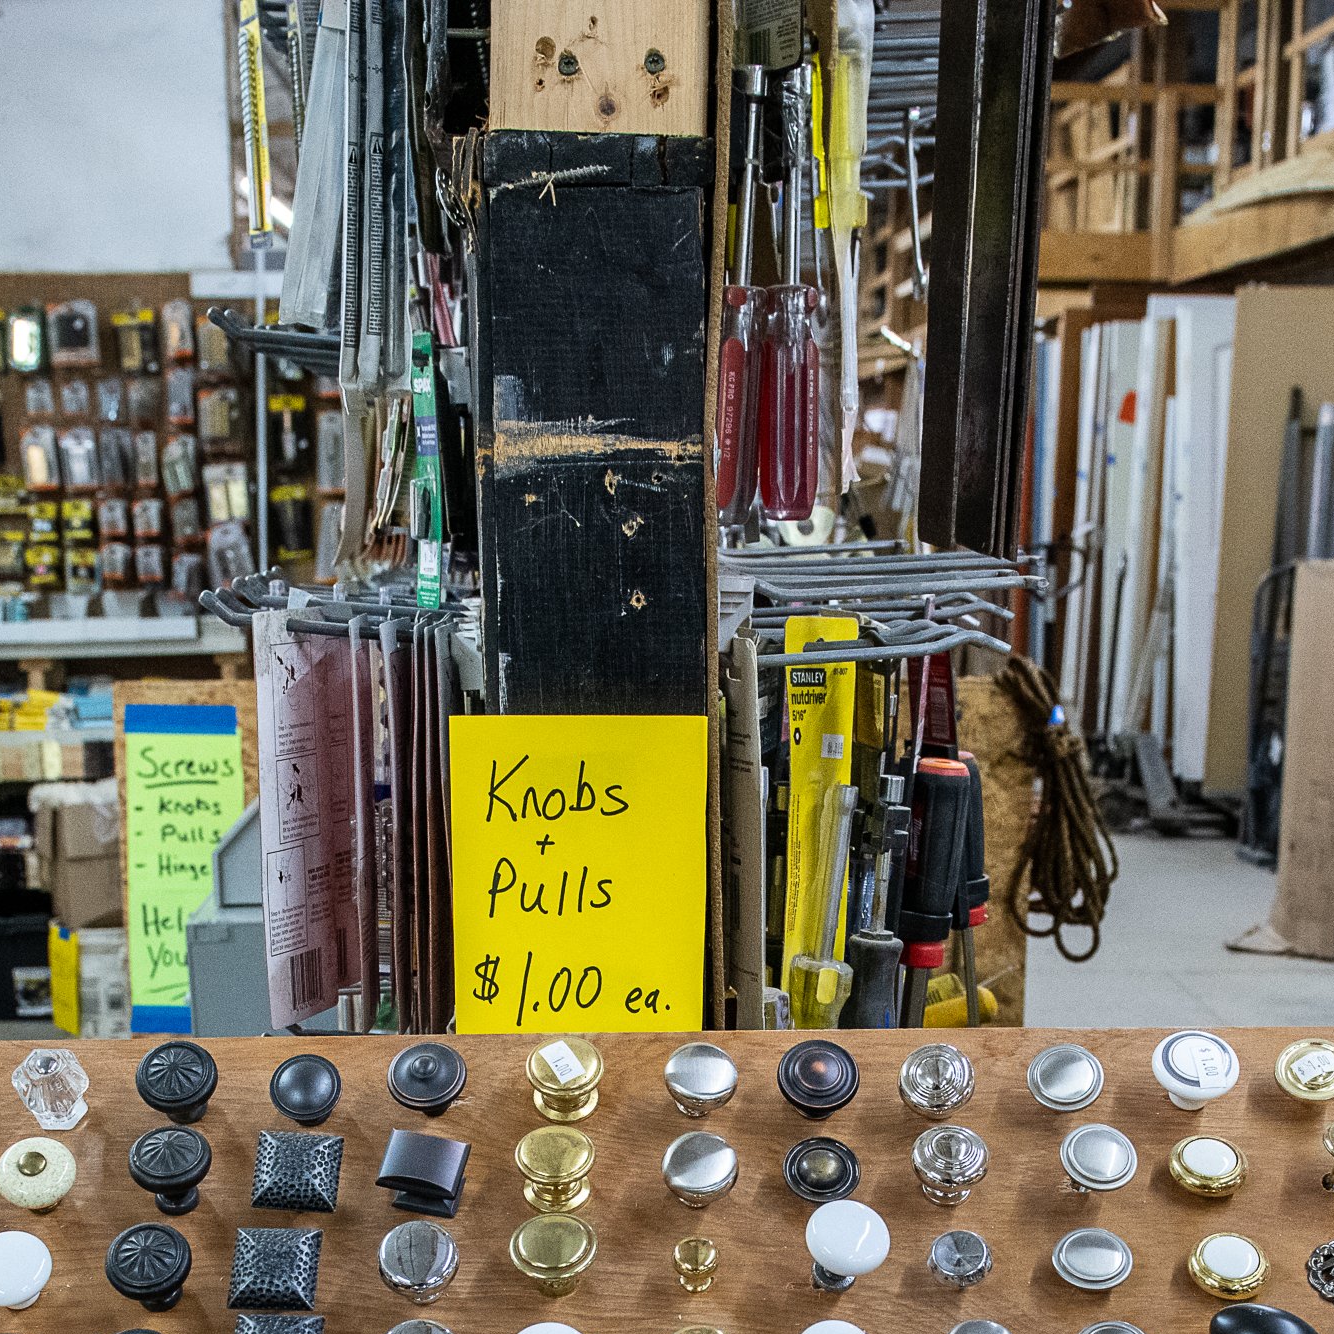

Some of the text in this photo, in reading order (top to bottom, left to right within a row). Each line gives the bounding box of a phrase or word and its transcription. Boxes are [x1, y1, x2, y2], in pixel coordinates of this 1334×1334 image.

[727, 384, 735, 400] PRO
[725, 406, 733, 434] 97296
[792, 671, 825, 684] STANLEY
[791, 689, 827, 705] nutdriver
[792, 709, 807, 722] 5/16"
[136, 746, 236, 780] Screws
[486, 754, 629, 822] Knobs
[158, 796, 222, 816] Knobs
[160, 824, 221, 845] Pulls
[535, 834, 555, 855] +
[488, 857, 613, 919] Pulls
[142, 903, 183, 938] Hel
[624, 987, 671, 1014] ea.
